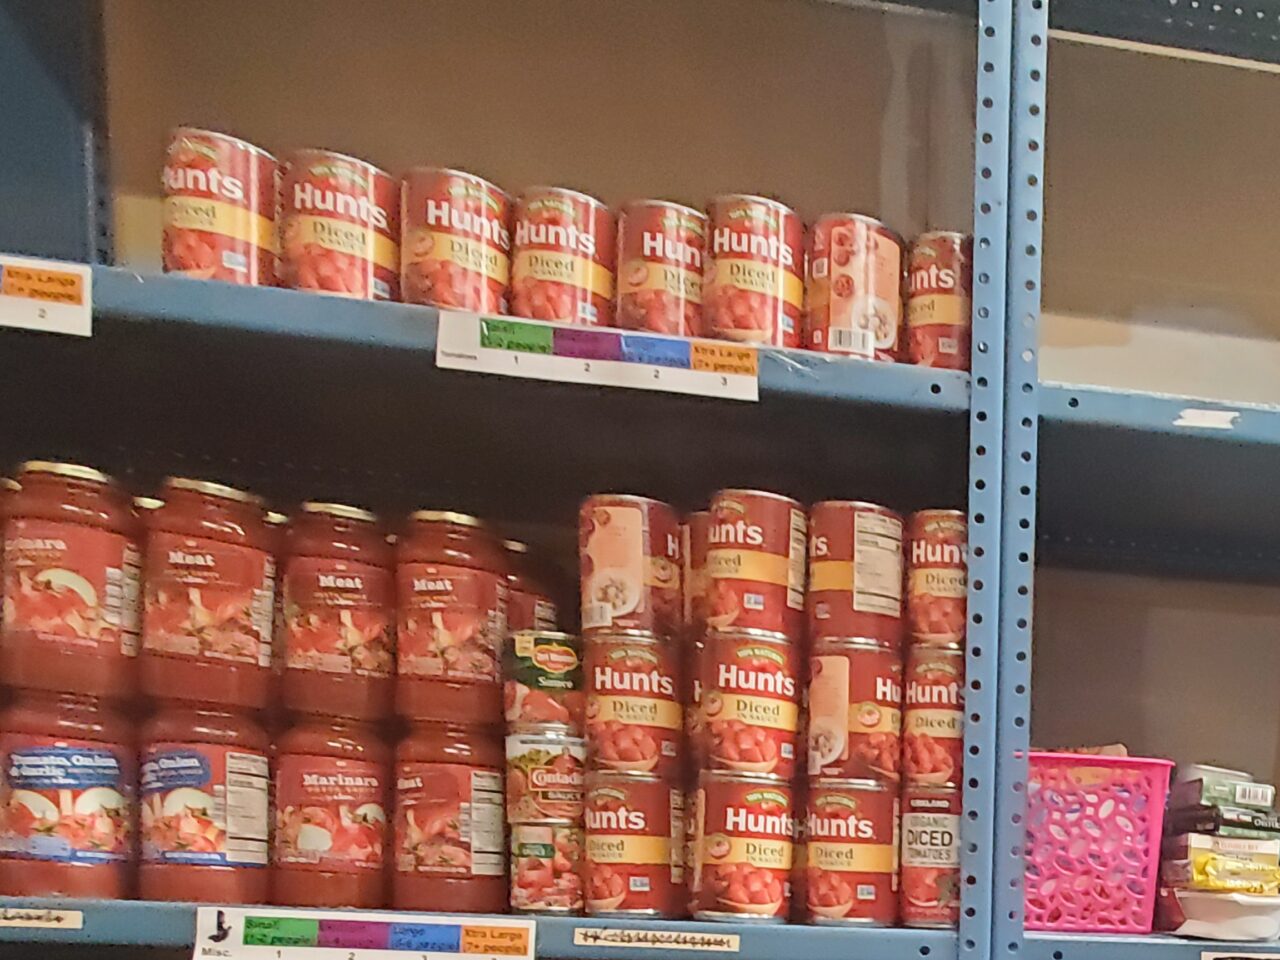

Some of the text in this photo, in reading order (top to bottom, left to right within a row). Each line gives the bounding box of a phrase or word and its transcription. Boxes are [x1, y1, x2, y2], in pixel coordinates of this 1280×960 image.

[642, 231, 701, 268] Hun
[528, 254, 576, 273] Diced
[663, 269, 700, 289] Dice
[729, 262, 777, 284] Diced
[708, 520, 764, 545] unts
[319, 574, 363, 591] Meat
[612, 702, 658, 714] Diced
[735, 699, 781, 717] Diced
[907, 830, 953, 847] DICED
[745, 842, 785, 858] Diced
